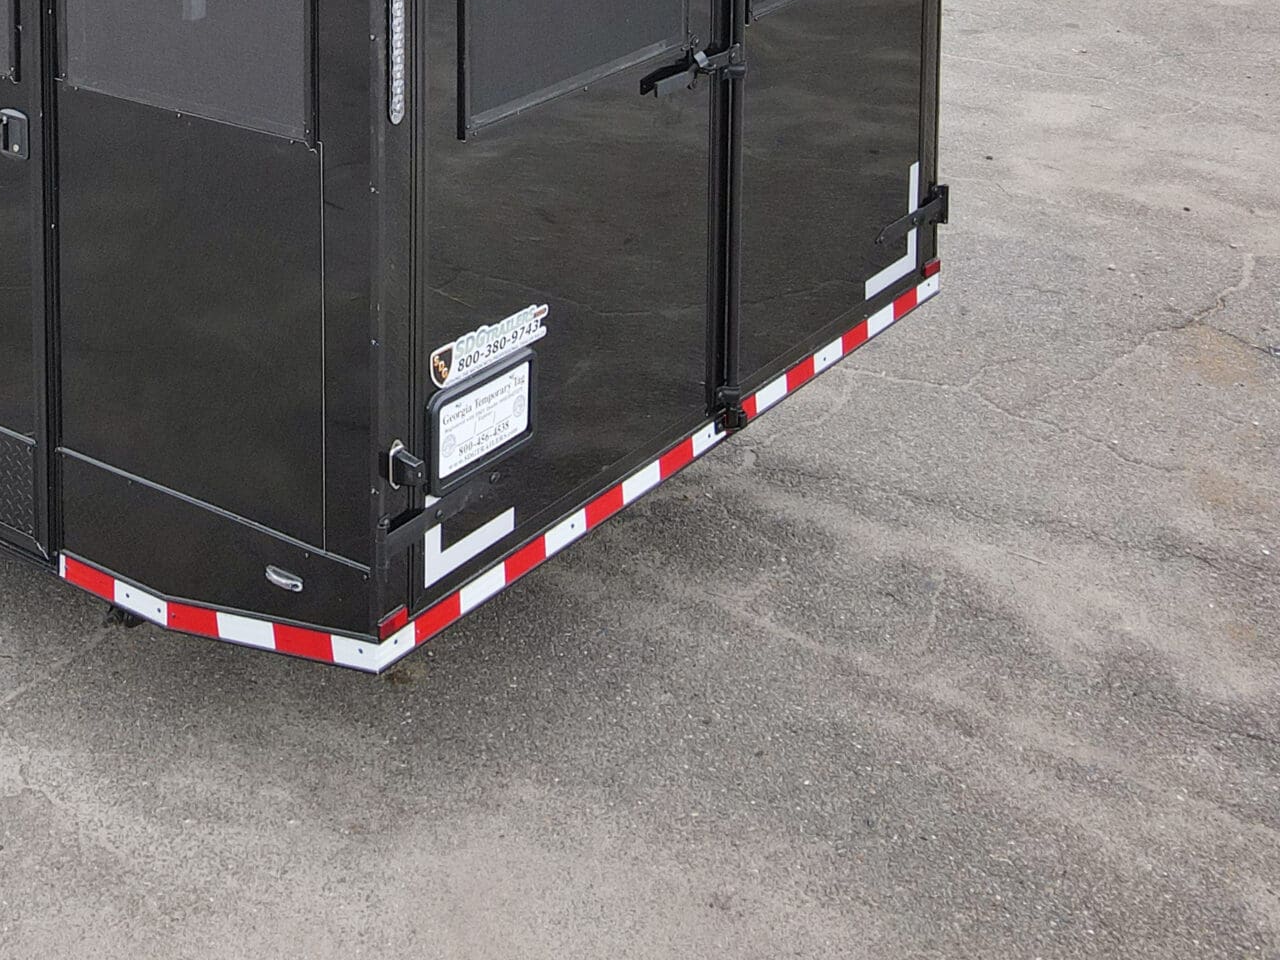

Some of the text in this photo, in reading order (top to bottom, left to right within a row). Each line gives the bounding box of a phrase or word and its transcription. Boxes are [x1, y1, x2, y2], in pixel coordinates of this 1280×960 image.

[457, 319, 539, 373] 800-380-9743
[442, 404, 472, 426] Georgia
[474, 384, 511, 408] Temporary
